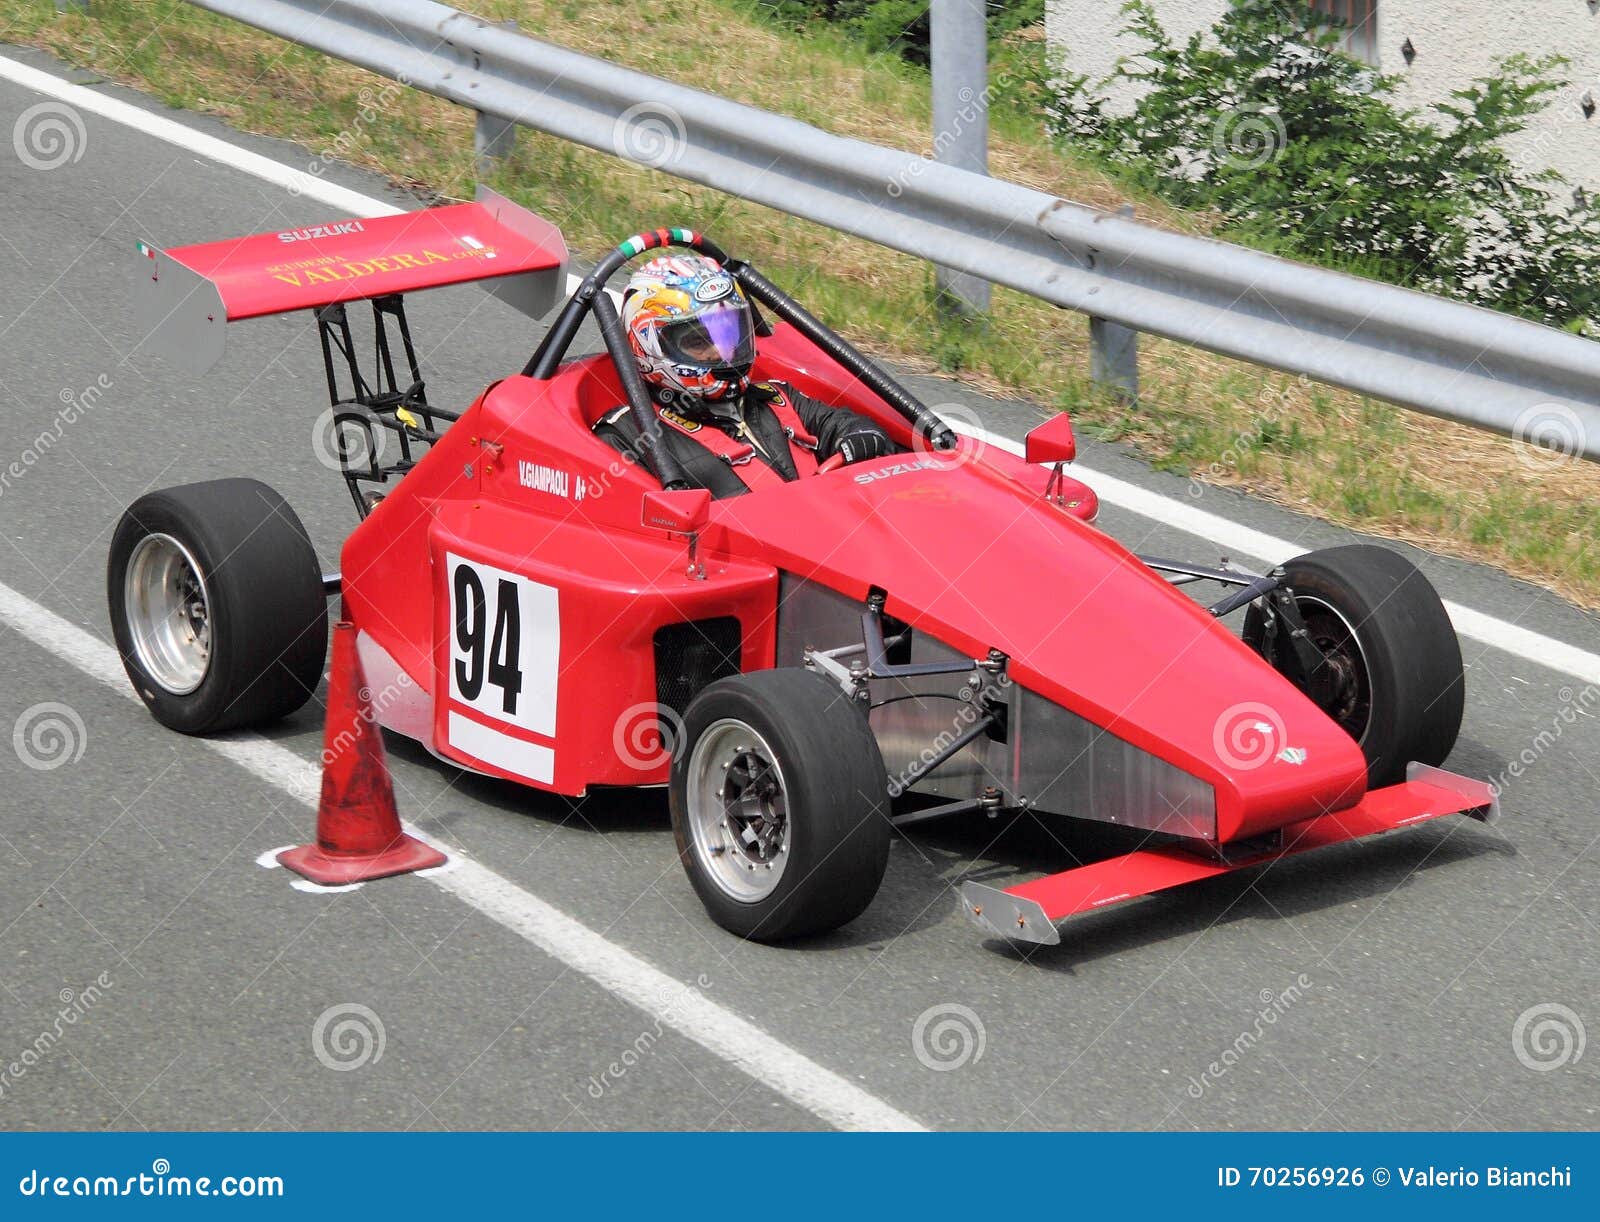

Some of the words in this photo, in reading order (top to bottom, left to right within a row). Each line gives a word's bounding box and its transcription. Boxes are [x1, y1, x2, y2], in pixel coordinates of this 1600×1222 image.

[277, 221, 365, 243] SUZUKI
[273, 249, 448, 288] VALDERA
[518, 460, 569, 498] V.GIAMPAOLI
[454, 564, 522, 716] 94
